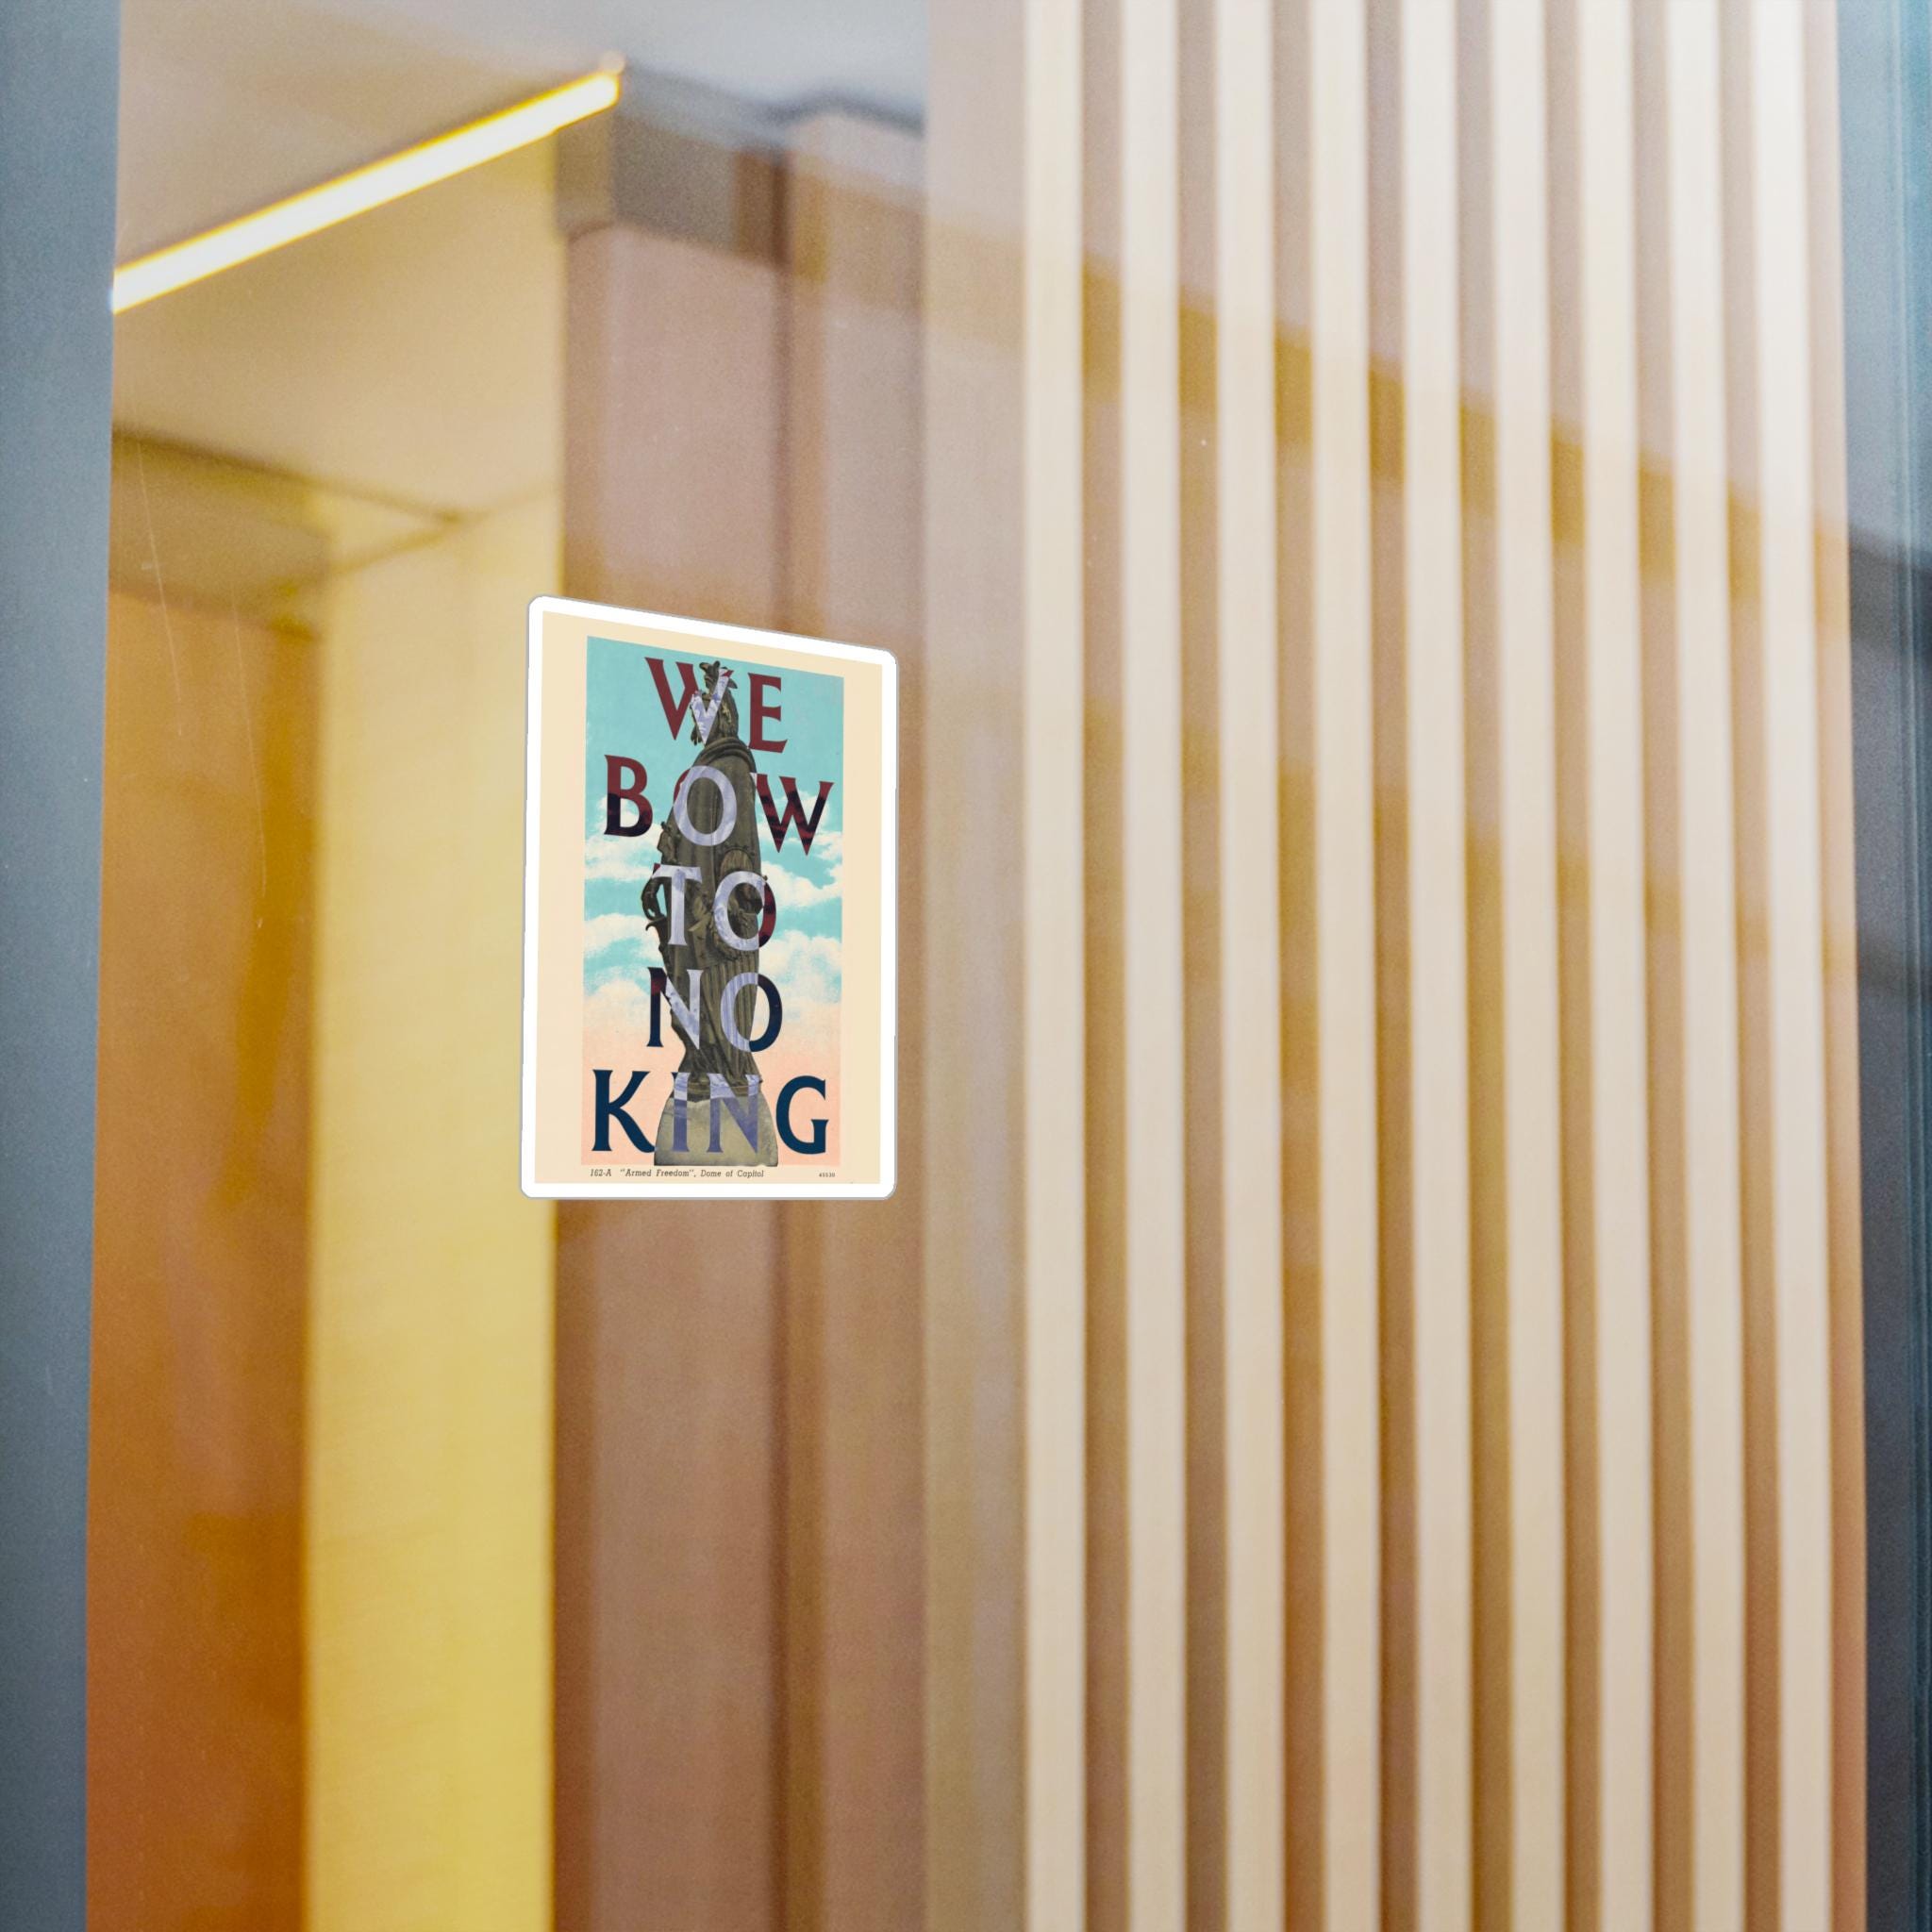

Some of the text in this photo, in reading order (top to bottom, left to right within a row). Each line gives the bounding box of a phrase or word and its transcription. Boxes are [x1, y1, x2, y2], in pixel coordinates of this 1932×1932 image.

[644, 657, 788, 753] WE
[604, 755, 834, 856] BOW
[653, 863, 776, 952] TO
[646, 966, 782, 1053] NO
[591, 1069, 829, 1155] KING
[620, 1169, 652, 1177] "Armed
[737, 1170, 764, 1178] Capitol
